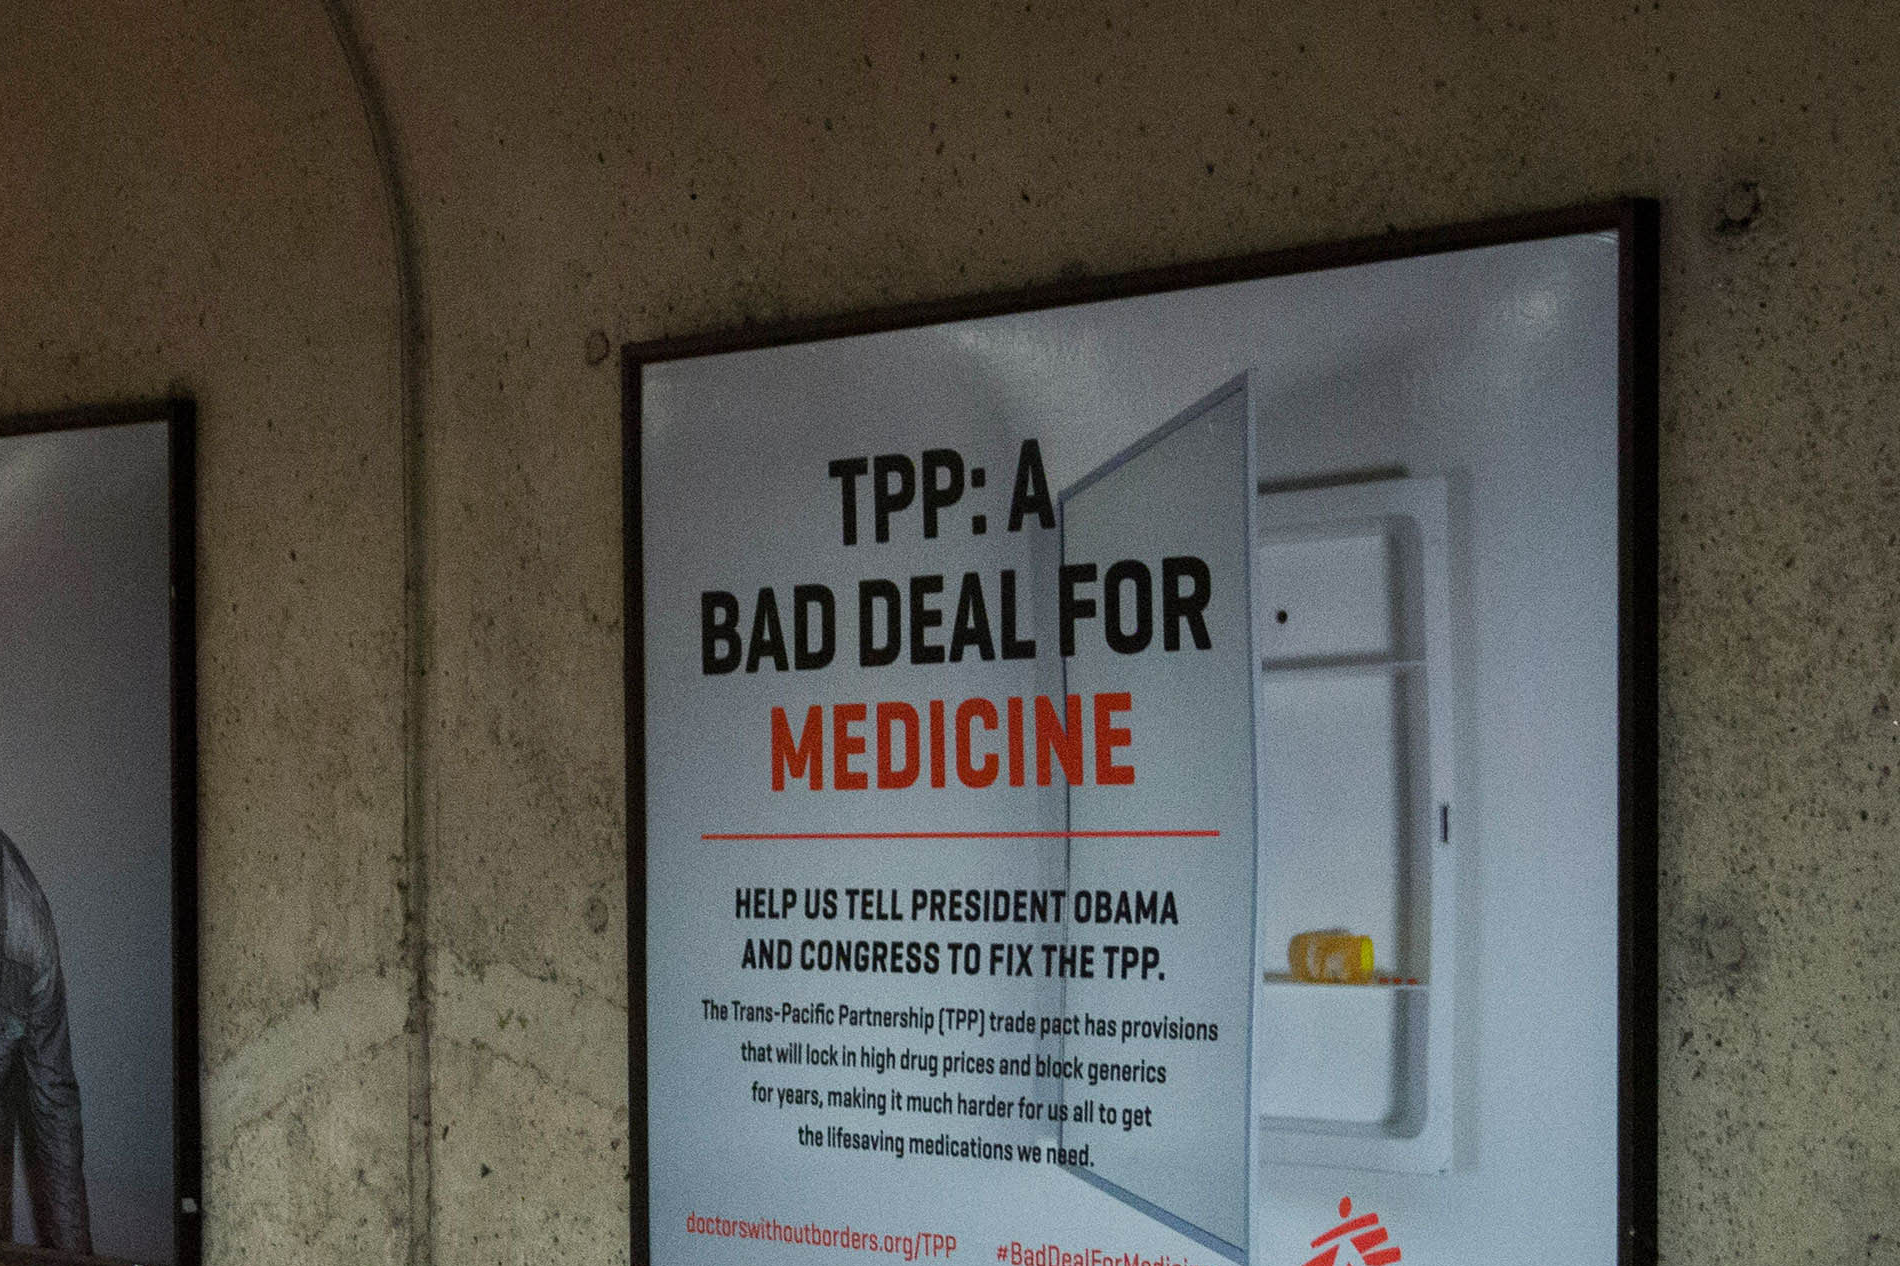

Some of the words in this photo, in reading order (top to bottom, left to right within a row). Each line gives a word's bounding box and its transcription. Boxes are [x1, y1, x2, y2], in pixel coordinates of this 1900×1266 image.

[829, 448, 988, 546] TPP:
[1007, 438, 1057, 532] A
[701, 583, 838, 676] BAD
[858, 569, 1037, 668] DEAL
[1058, 555, 1213, 657] FOR
[771, 692, 1135, 792] MEDICINE
[735, 888, 798, 919] HELP
[804, 888, 838, 920] US
[845, 888, 904, 921] TELL
[911, 889, 1066, 923] PRESIDENT
[1074, 890, 1179, 925] OBAMA
[741, 939, 793, 970] AND
[800, 939, 940, 975] CONGRESS
[947, 942, 981, 975] TO
[989, 943, 1034, 977] FIX
[1041, 944, 1095, 979] THE
[1102, 946, 1166, 981] TPP.
[701, 1000, 728, 1021] The
[731, 1001, 835, 1025] Trans-Pacific
[839, 1004, 934, 1034] Partnership
[989, 1011, 1035, 1033] trade
[1040, 1014, 1080, 1040] pact
[1085, 1013, 1117, 1038] has
[1121, 1016, 1219, 1043] provisions
[740, 1041, 772, 1063] that
[775, 1042, 802, 1065] will
[806, 1043, 838, 1067] lock
[842, 1045, 857, 1067] in
[861, 1046, 896, 1074] high
[900, 1048, 938, 1077] drug
[943, 1051, 994, 1077] prices
[999, 1054, 1031, 1077] and
[1035, 1054, 1084, 1080] block
[1088, 1059, 1167, 1085] generics
[751, 1081, 774, 1102] for
[777, 1085, 824, 1109] years,
[827, 1087, 886, 1116] making
[891, 1088, 903, 1111] it
[906, 1092, 953, 1115] much
[957, 1093, 1014, 1119] harder
[1018, 1096, 1043, 1121] for
[1048, 1103, 1068, 1122] us
[1073, 1100, 1094, 1123] all
[1098, 1103, 1117, 1125] to
[1122, 1106, 1152, 1131] get
[798, 1124, 823, 1147] the
[827, 1126, 904, 1158] lifesaving
[909, 1134, 1013, 1162] medications
[1017, 1145, 1042, 1164] we
[1046, 1144, 1095, 1167] need.
[686, 1211, 957, 1261] doctorswithoutborders.org/TPP
